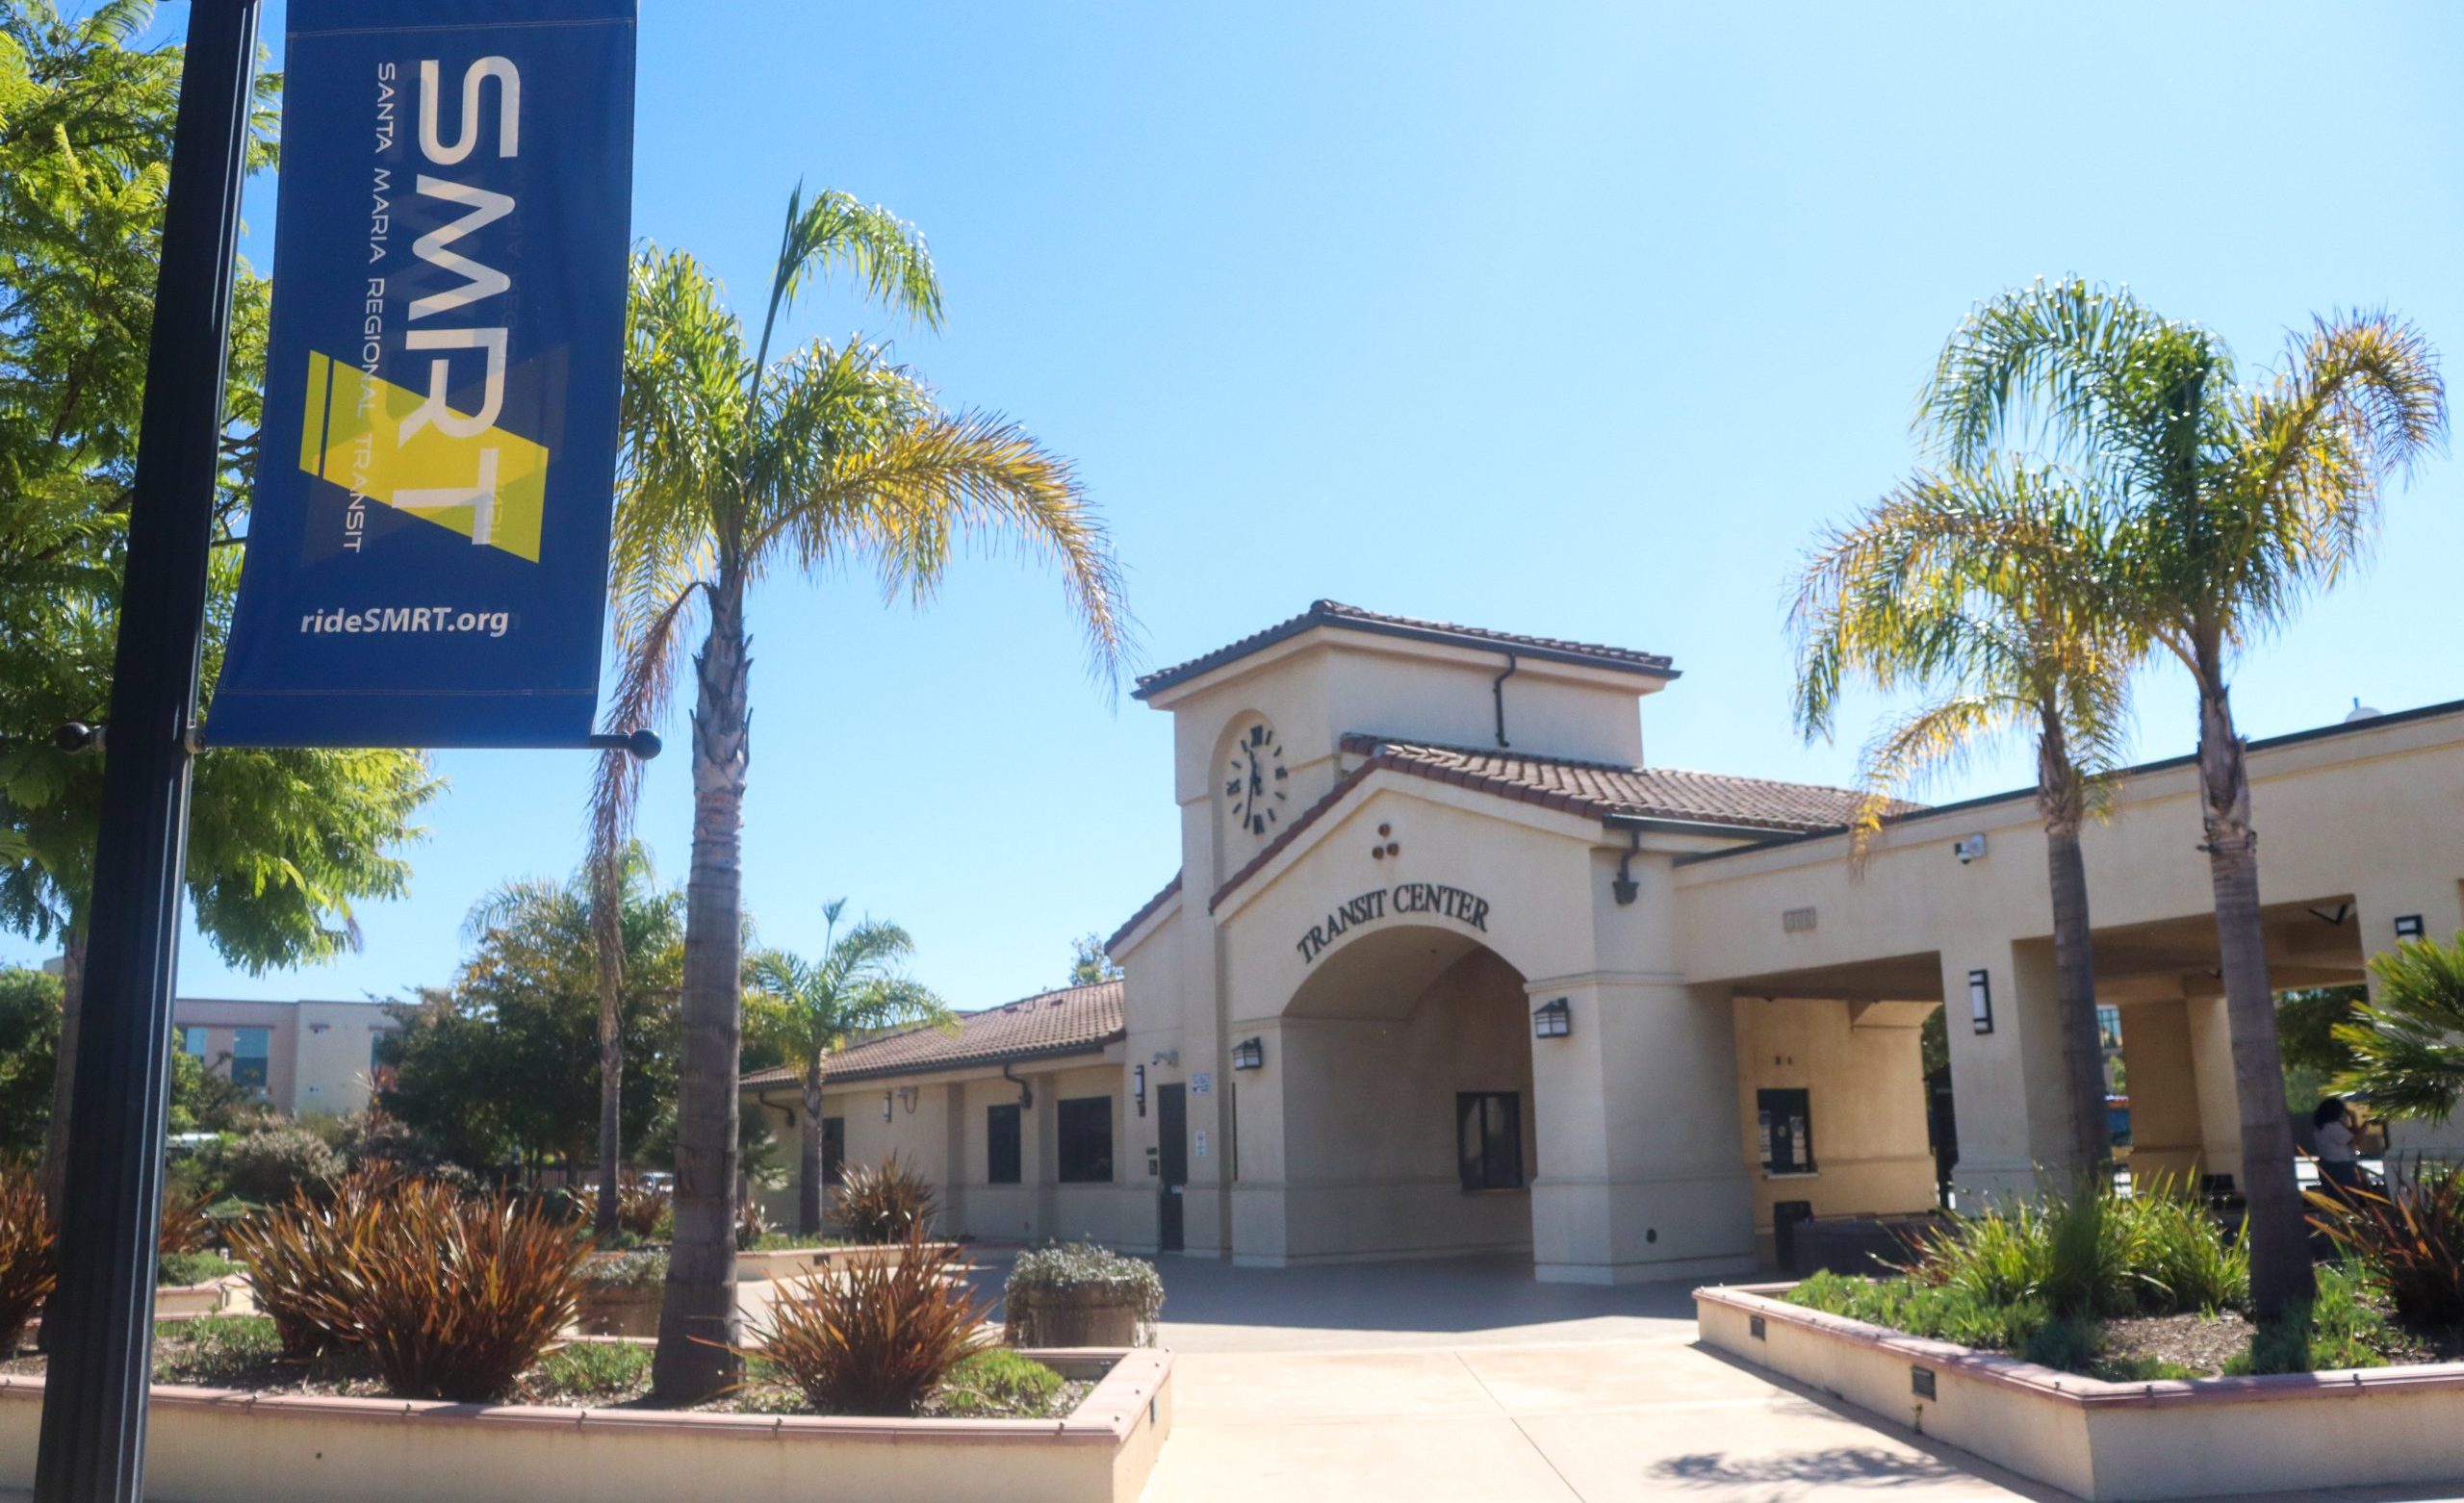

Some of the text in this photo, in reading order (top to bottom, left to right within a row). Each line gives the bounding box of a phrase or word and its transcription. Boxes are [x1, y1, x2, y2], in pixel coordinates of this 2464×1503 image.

[343, 62, 397, 553] SANTA MARIA REGIONAL TRANSIT
[392, 55, 521, 546] SMRT
[300, 607, 509, 638] rideSMRT.org
[1296, 883, 1491, 964] TRANSIT CENTER
